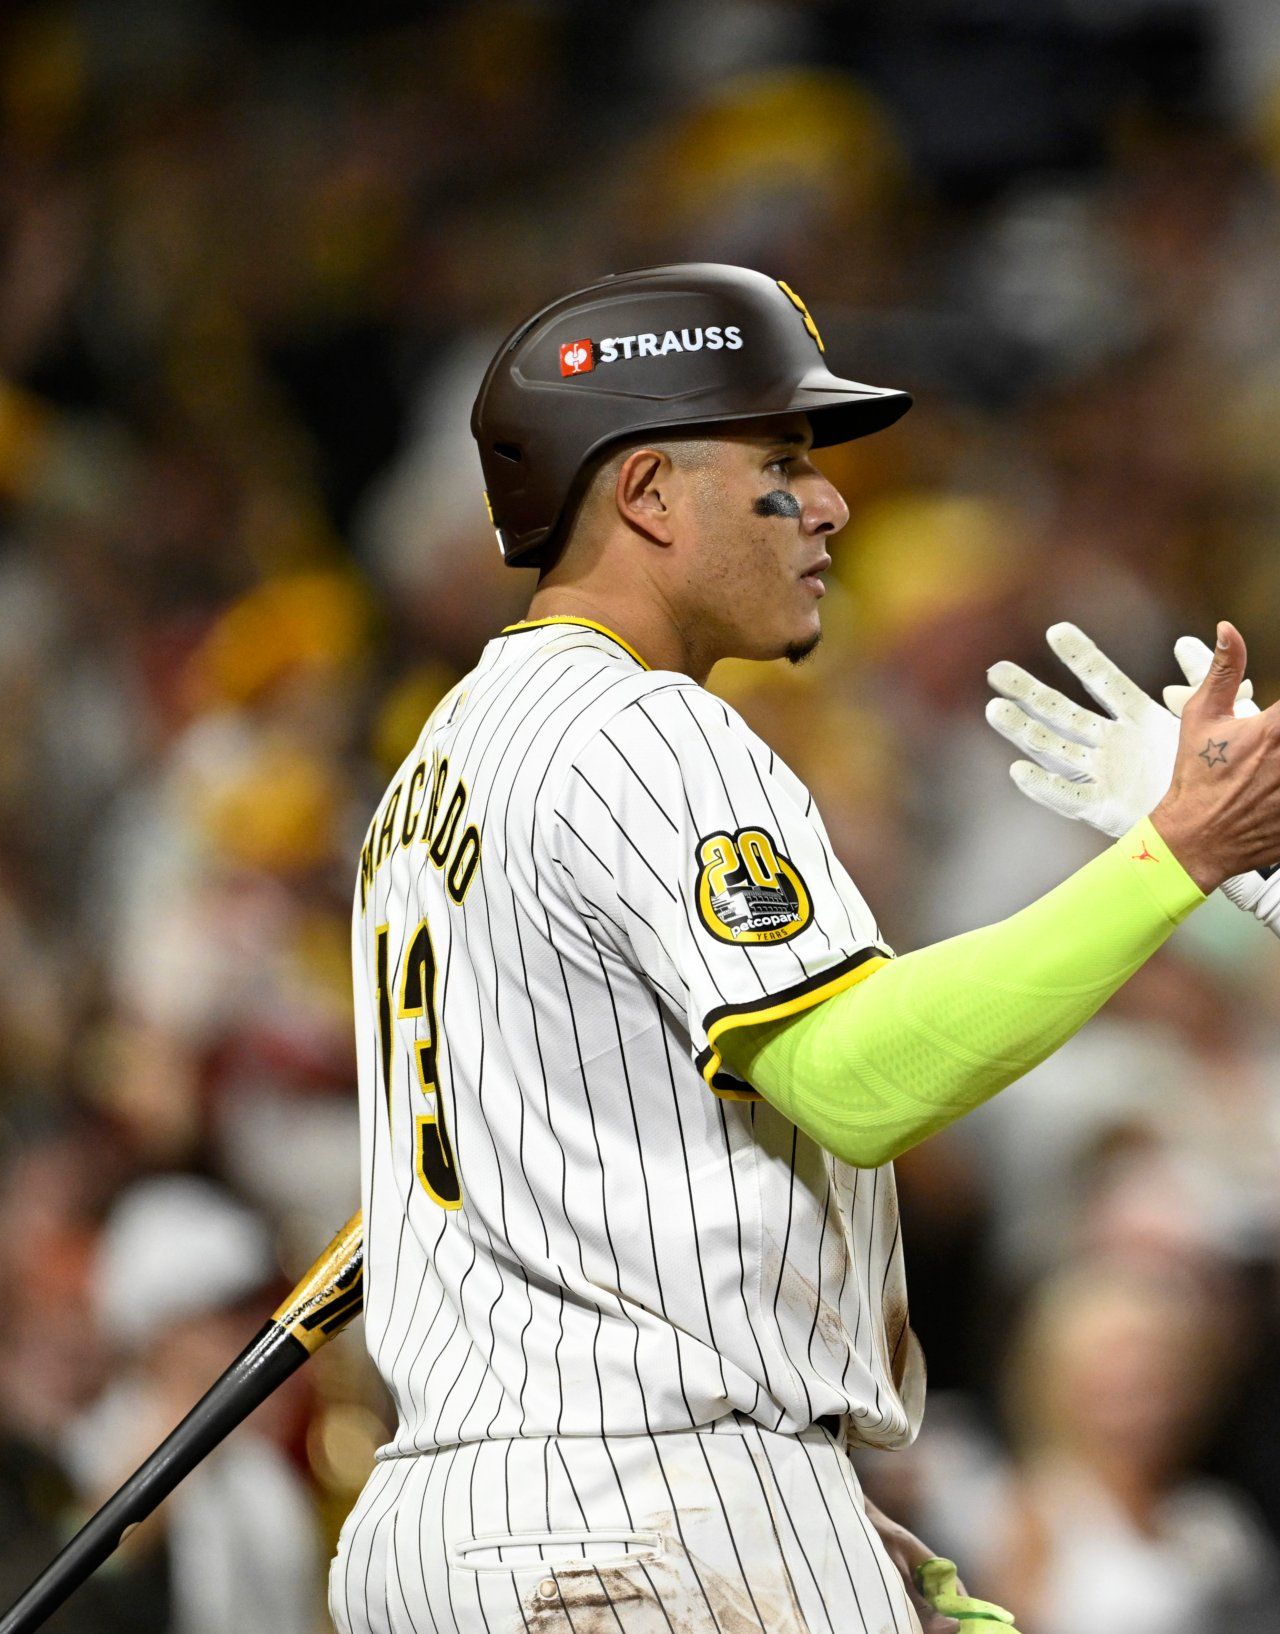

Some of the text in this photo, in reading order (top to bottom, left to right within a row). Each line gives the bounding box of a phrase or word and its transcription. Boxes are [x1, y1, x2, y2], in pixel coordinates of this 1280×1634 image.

[599, 325, 744, 364] STRAUSS
[701, 830, 781, 900] 20
[731, 912, 801, 938] petcopark
[756, 928, 789, 941] YEARS
[374, 917, 464, 1211] 13
